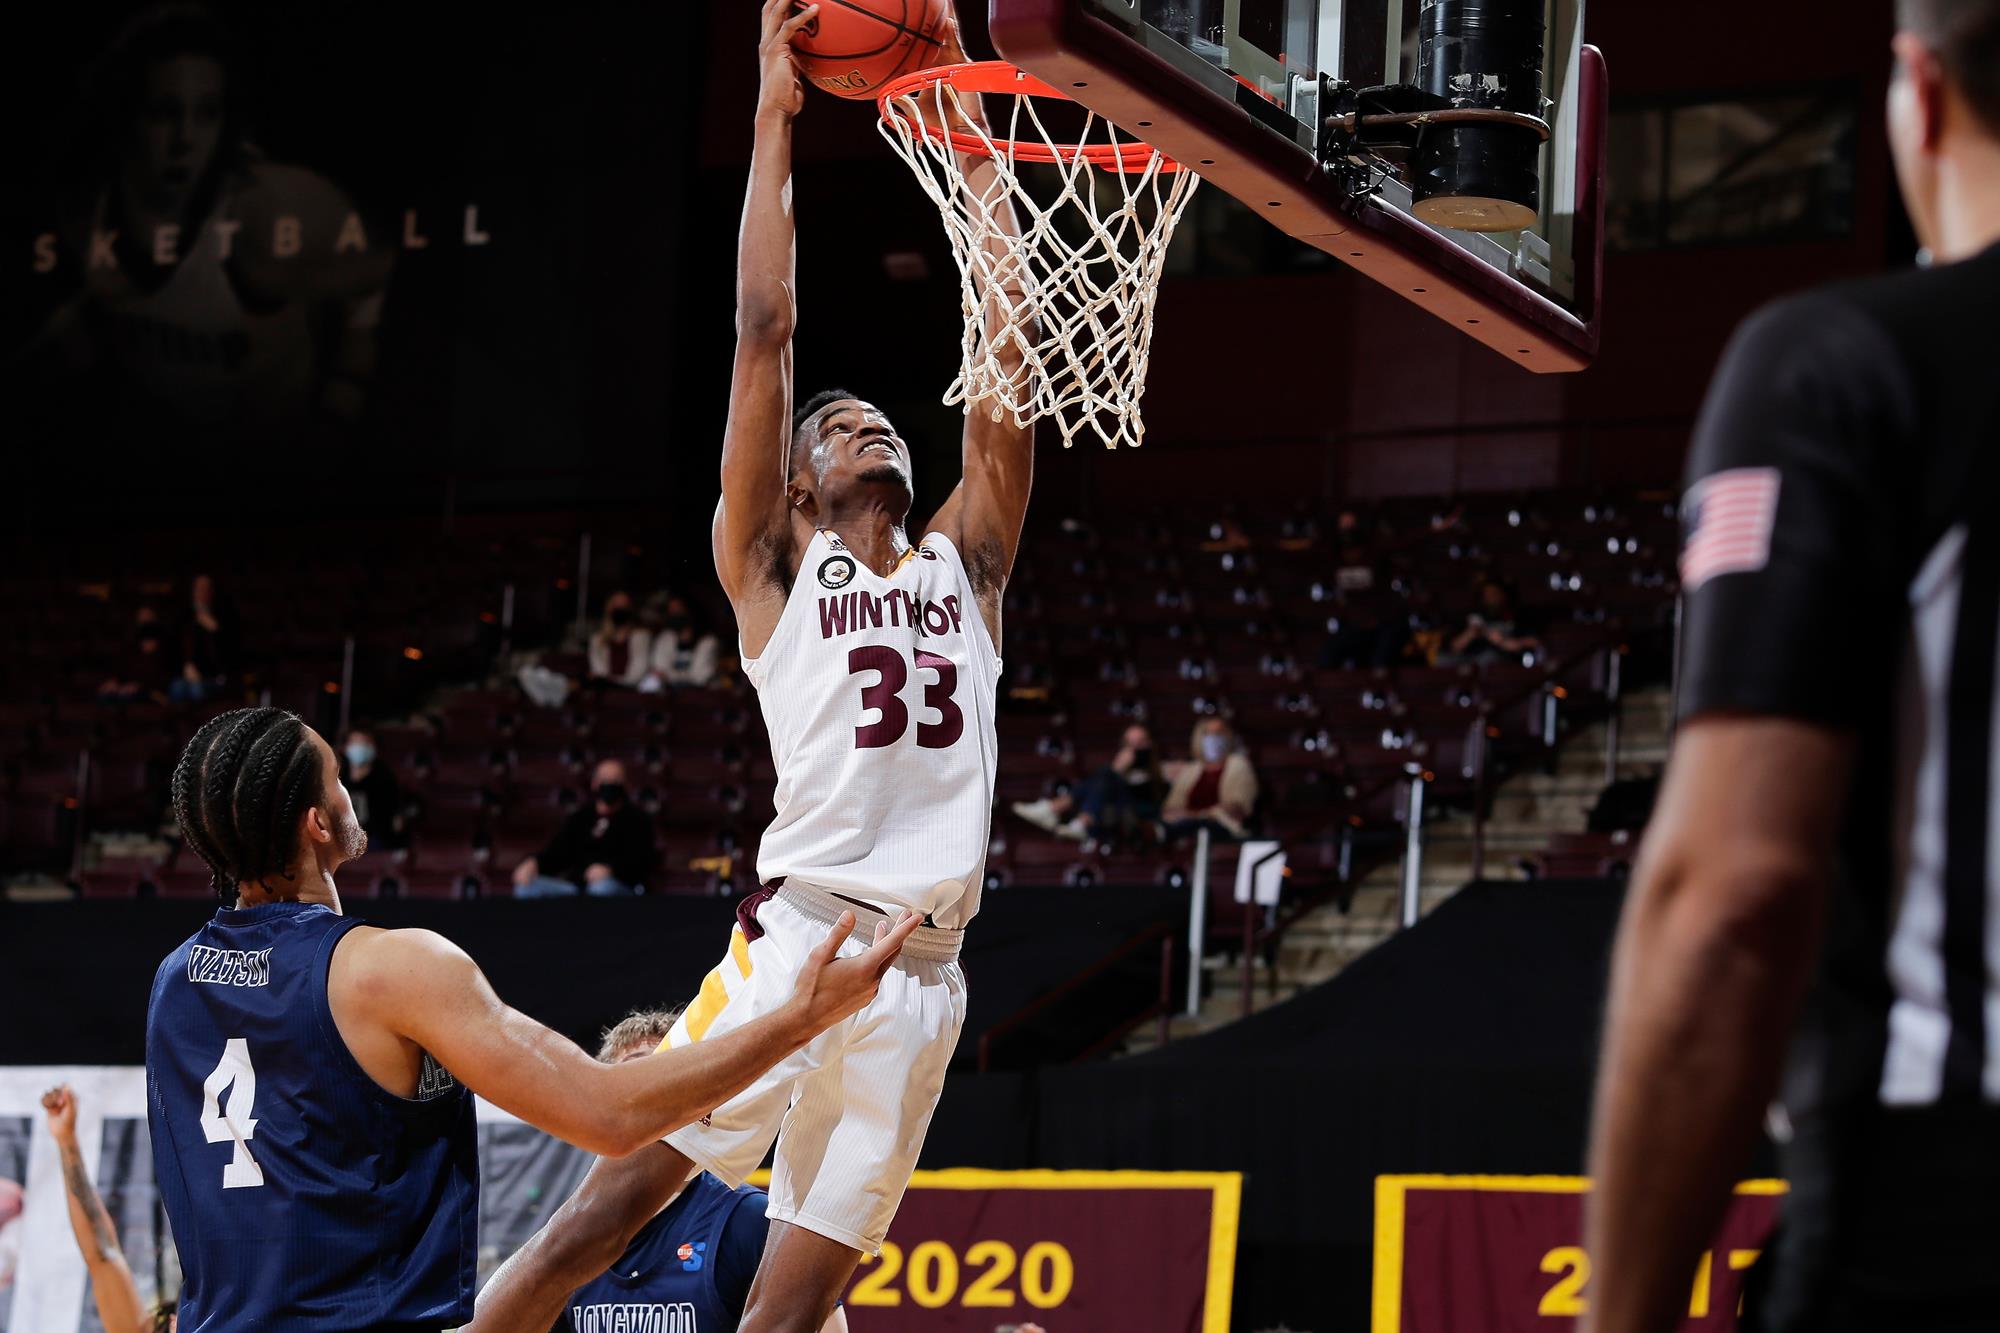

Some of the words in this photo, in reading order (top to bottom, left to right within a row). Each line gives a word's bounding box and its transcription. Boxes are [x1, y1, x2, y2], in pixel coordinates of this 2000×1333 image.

[848, 645, 963, 749] 33
[188, 945, 274, 987] WATSON
[200, 1038, 264, 1189] 4
[848, 1240, 1074, 1309] 2020
[573, 1303, 697, 1333] LONGWOOD
